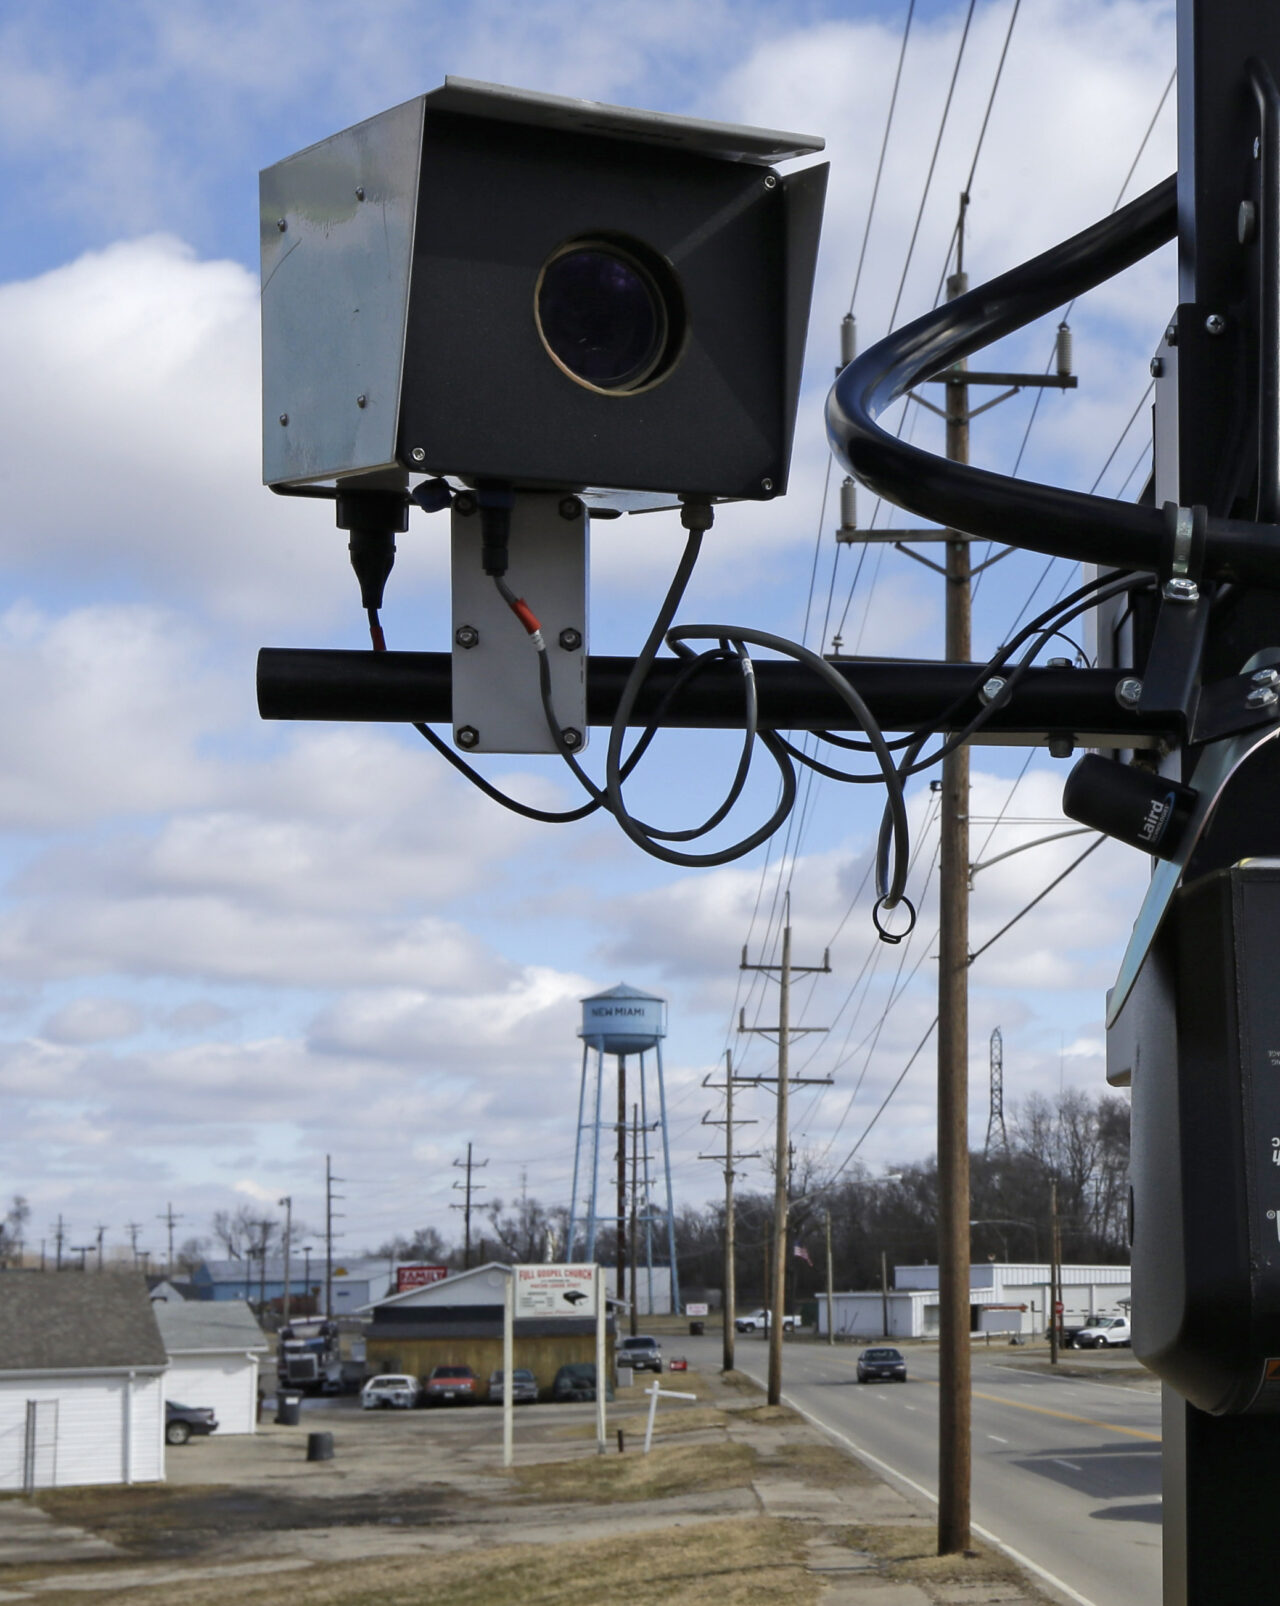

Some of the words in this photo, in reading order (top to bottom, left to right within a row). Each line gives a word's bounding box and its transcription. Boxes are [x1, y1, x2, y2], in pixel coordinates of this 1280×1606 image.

[1138, 800, 1164, 840] Laird
[592, 1008, 612, 1016] NEW
[615, 1008, 645, 1016] MIAMI
[519, 1269, 535, 1281] FULL
[537, 1269, 562, 1278] GOSPEL
[564, 1268, 593, 1280] CHURCH
